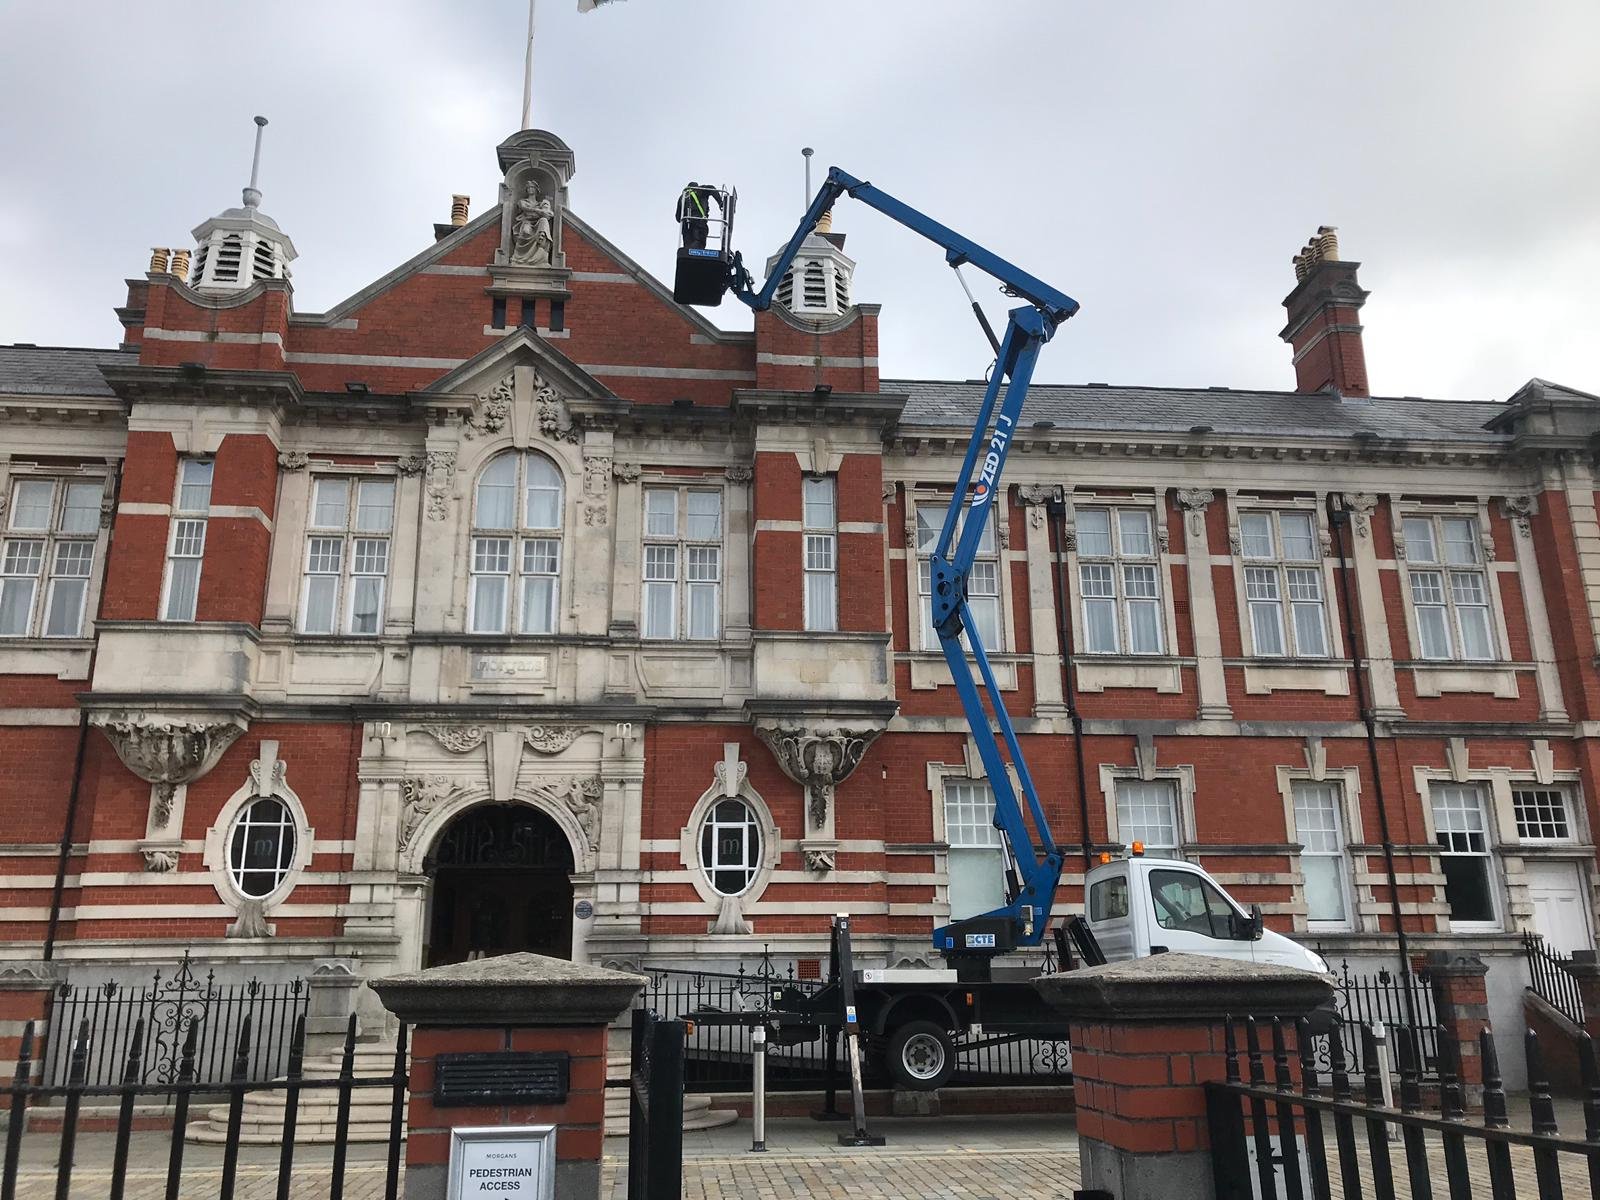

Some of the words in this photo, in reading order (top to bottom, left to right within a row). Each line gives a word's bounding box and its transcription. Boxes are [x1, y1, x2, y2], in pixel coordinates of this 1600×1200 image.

[980, 452, 1000, 486] ZED
[991, 430, 1008, 453] 21
[1000, 414, 1012, 427] J
[254, 839, 273, 857] m
[720, 838, 740, 855] m
[975, 934, 994, 944] CTE
[469, 1168, 532, 1178] PEDESTRIAN
[479, 1181, 521, 1191] ACCESS
